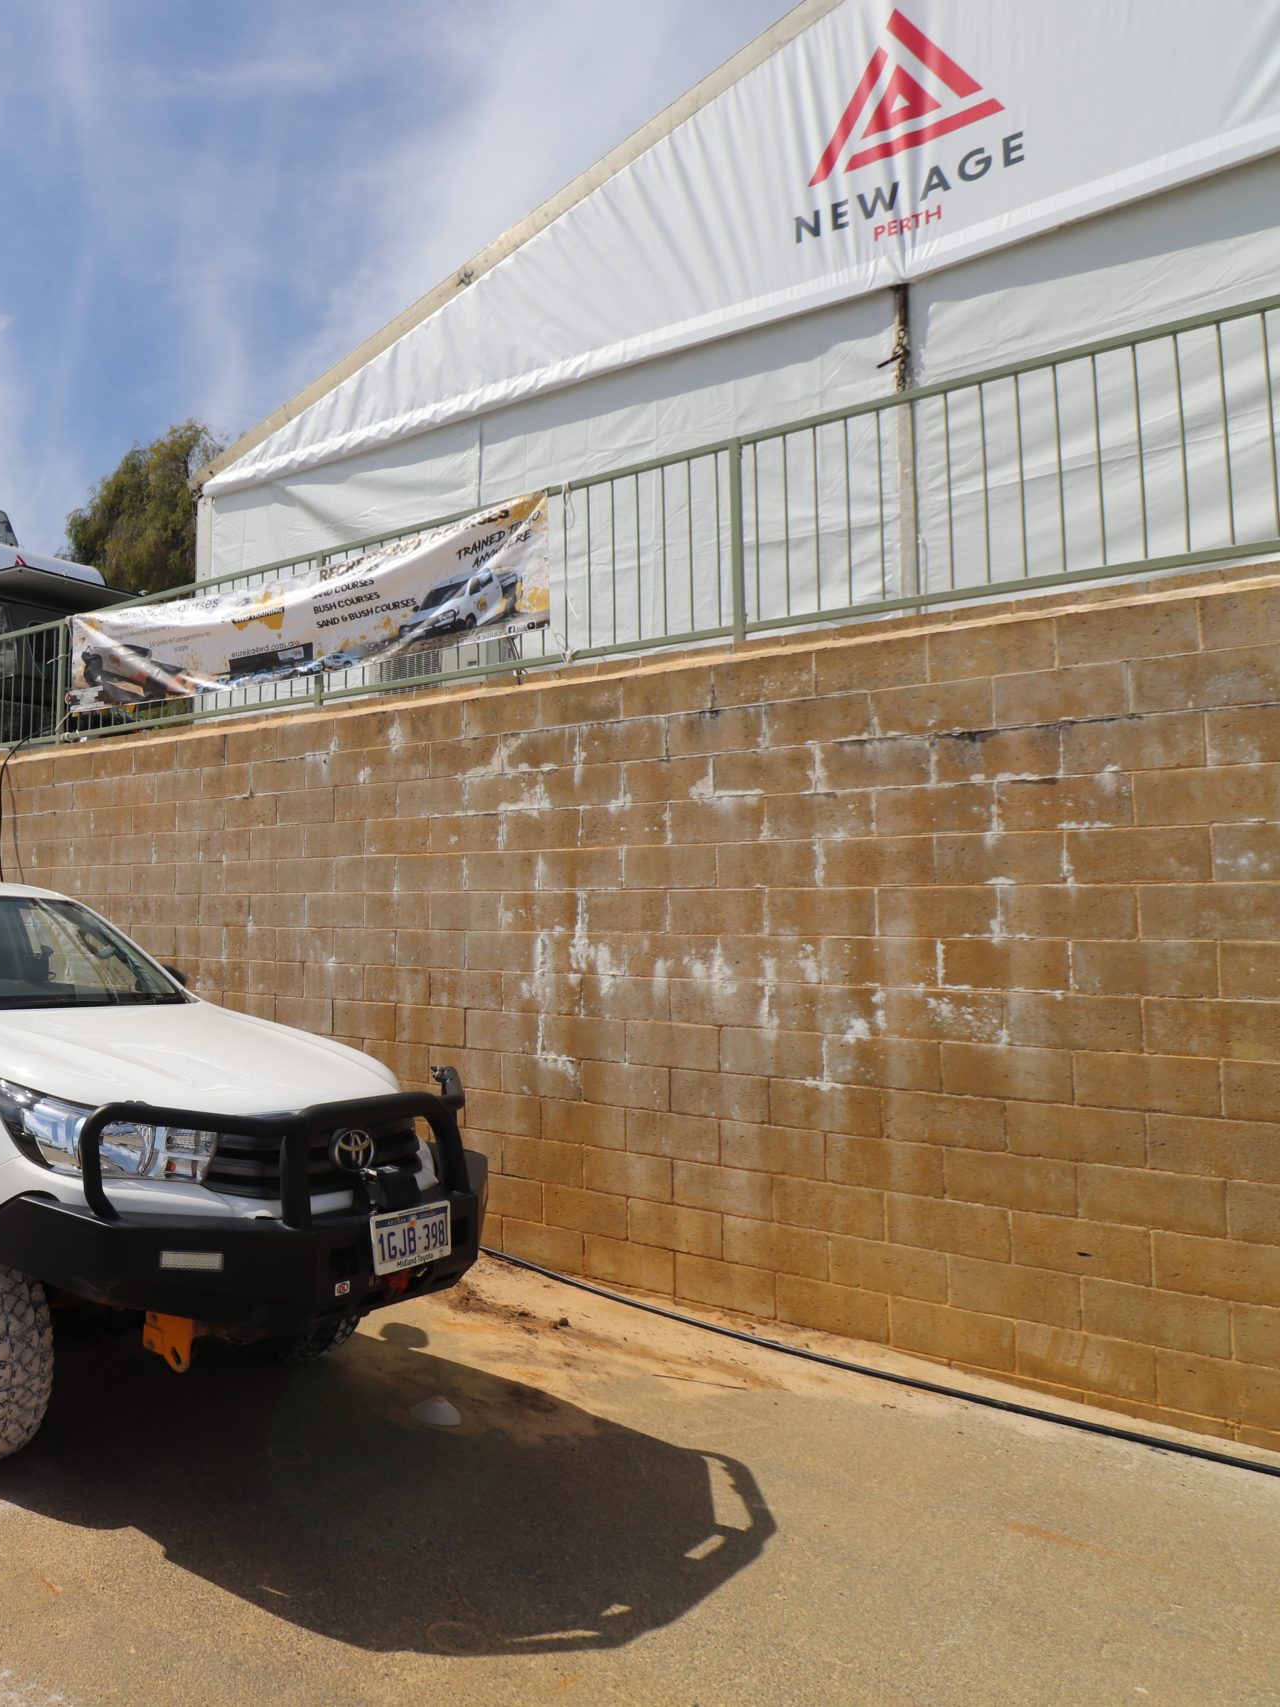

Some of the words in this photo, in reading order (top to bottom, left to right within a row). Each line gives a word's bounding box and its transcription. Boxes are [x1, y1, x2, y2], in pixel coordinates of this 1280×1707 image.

[794, 181, 900, 244] NEW
[920, 131, 1025, 202] AGE
[873, 204, 942, 242] PERTH
[456, 530, 505, 560] TRAINED
[334, 579, 374, 594] COURSES
[313, 603, 337, 614] BUSH
[338, 592, 380, 609] COURSES
[316, 617, 340, 628] SAND
[349, 607, 374, 621] BUSH
[375, 598, 416, 614] COURSES
[397, 1257, 417, 1268] Midland
[417, 1253, 434, 1264] Toyota
